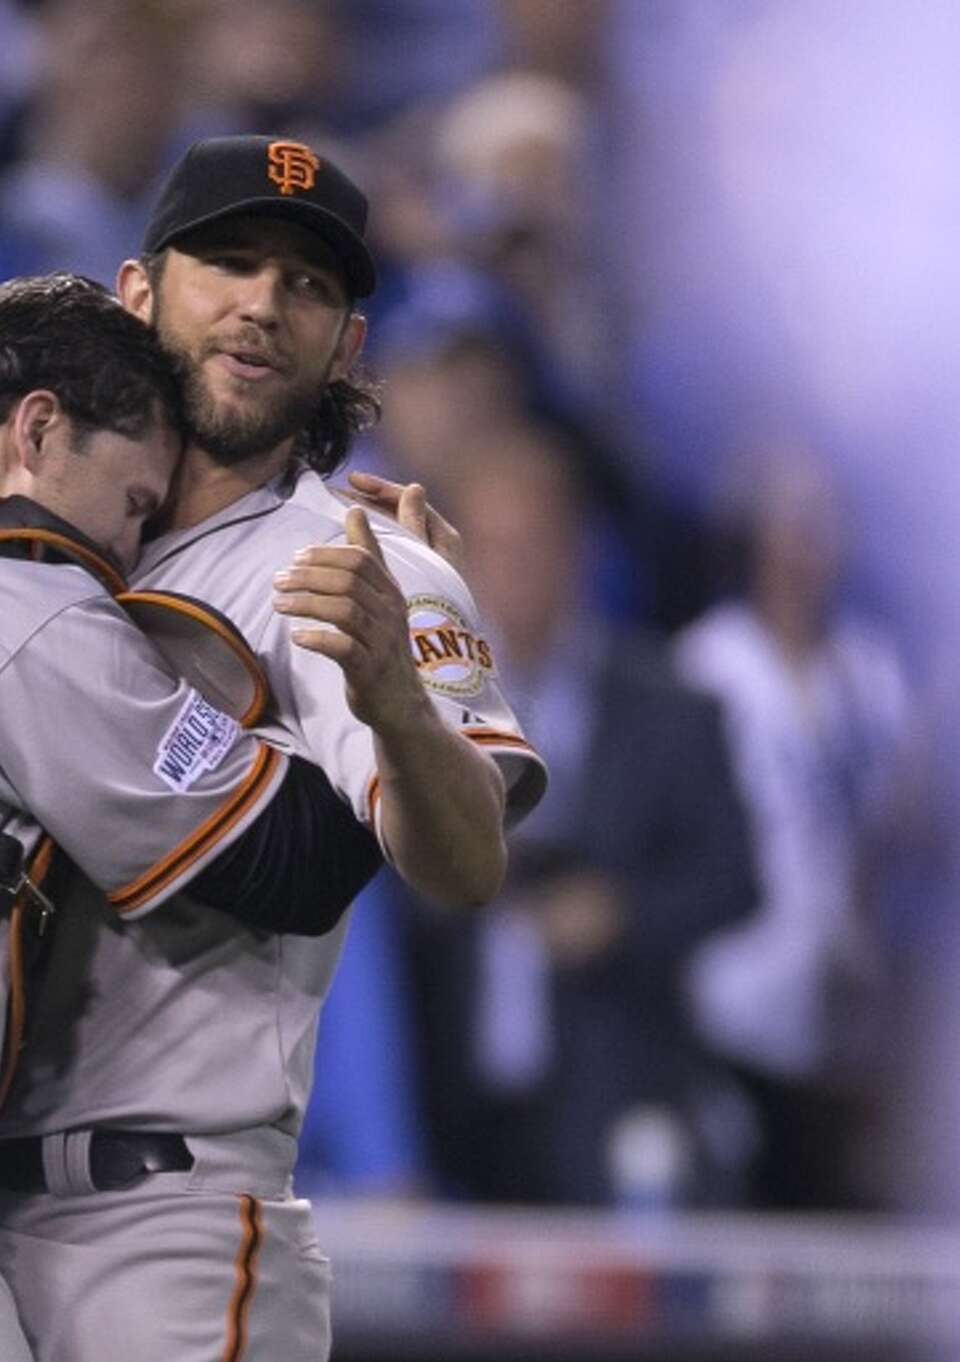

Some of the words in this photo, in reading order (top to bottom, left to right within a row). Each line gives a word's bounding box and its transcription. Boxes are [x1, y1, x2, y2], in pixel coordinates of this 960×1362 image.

[268, 142, 319, 195] SF
[413, 628, 493, 669] ANTS
[159, 714, 209, 783] WORLD
